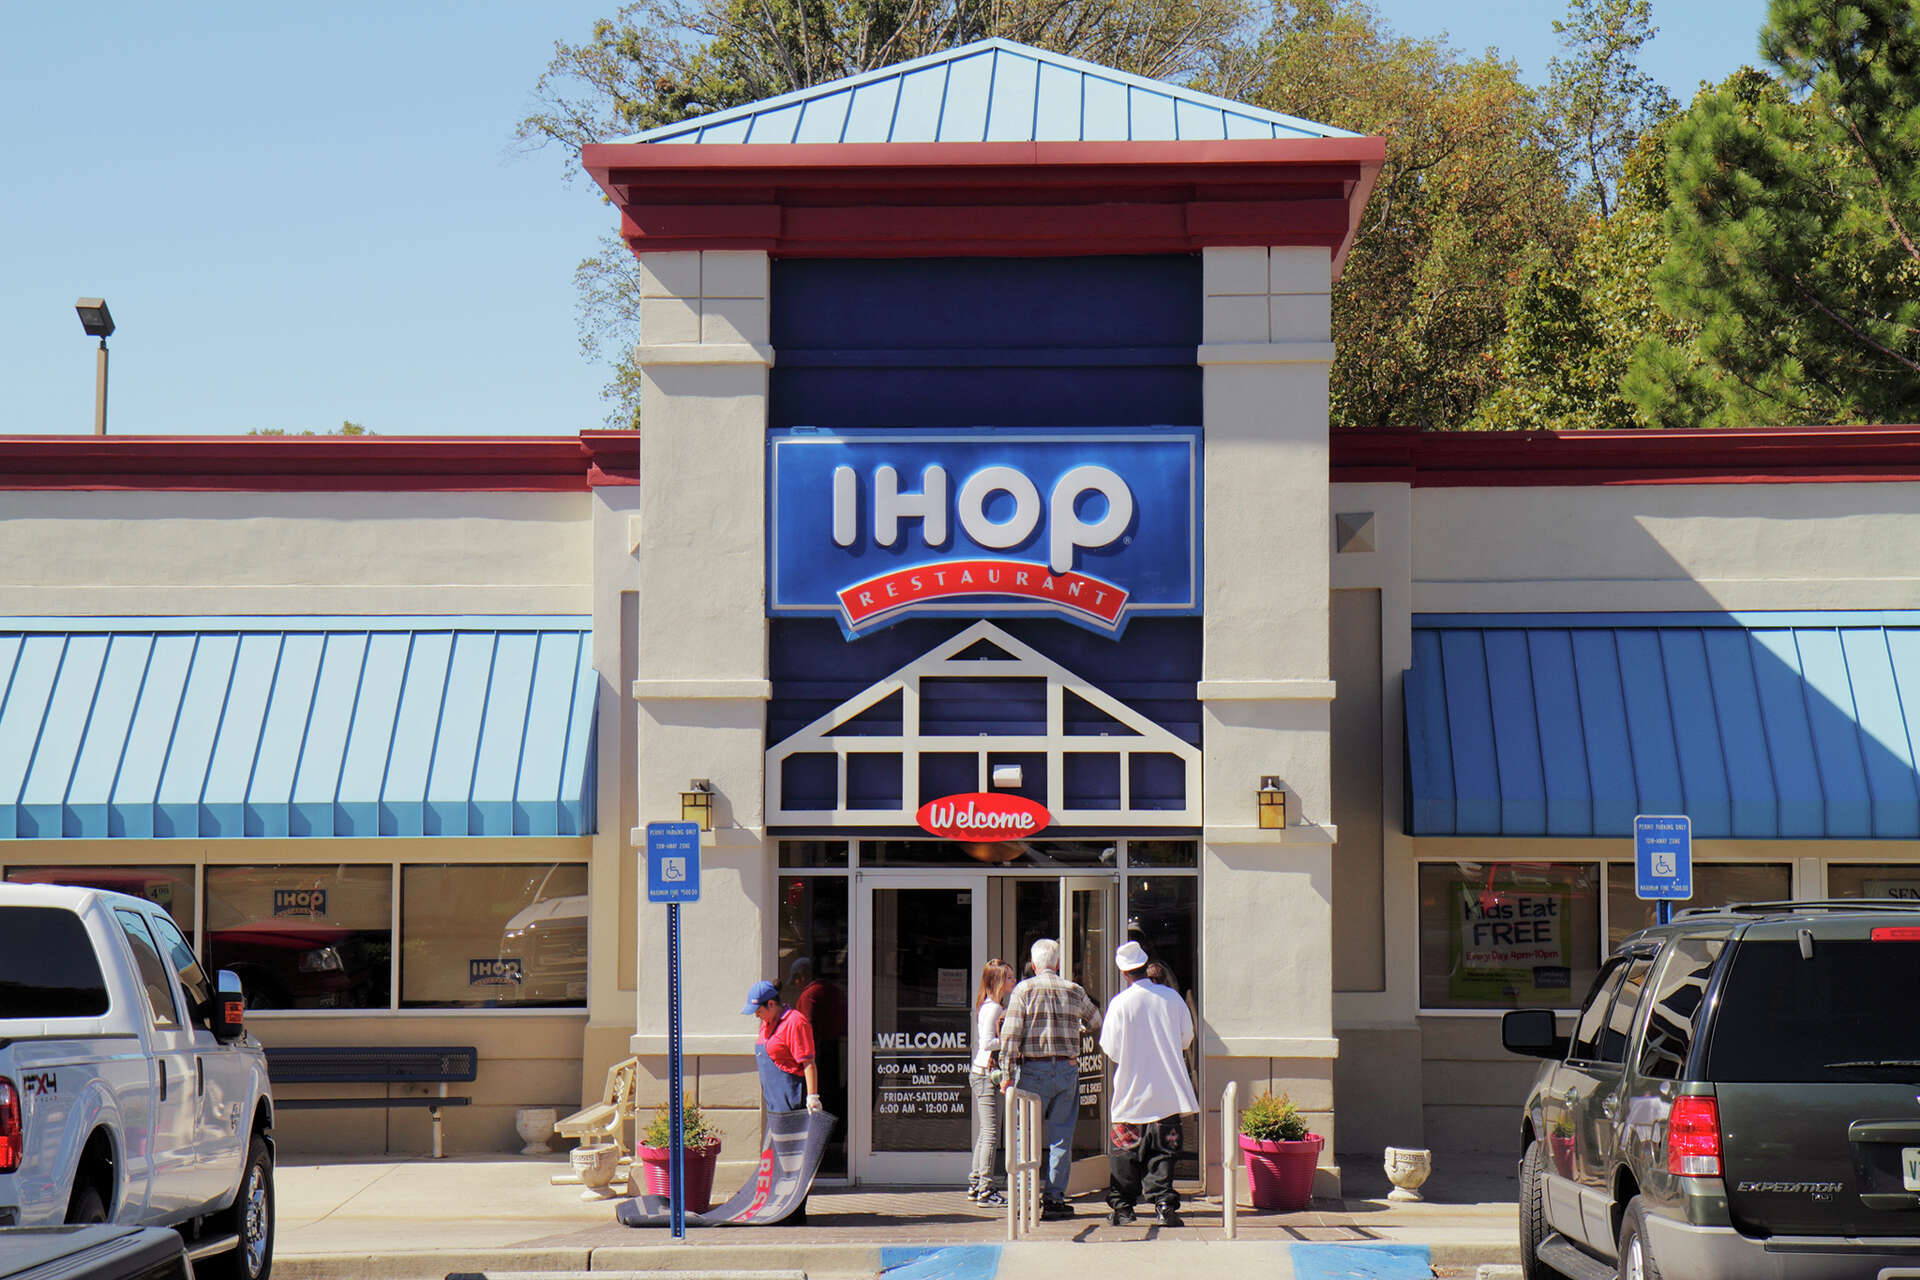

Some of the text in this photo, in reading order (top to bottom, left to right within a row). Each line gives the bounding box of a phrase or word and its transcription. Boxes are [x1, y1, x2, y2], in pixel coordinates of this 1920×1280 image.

[833, 465, 1134, 574] IHOP
[858, 569, 1108, 608] RESTAURANT
[930, 800, 1036, 830] Welcome
[276, 893, 324, 911] IHOP
[1464, 897, 1558, 921] Kids Eat
[1473, 920, 1553, 946] FREE
[1465, 951, 1491, 962] Every
[1491, 950, 1508, 961] Day
[877, 1031, 967, 1049] WELCOME
[1082, 1035, 1095, 1054] NO
[877, 1063, 900, 1074] 6:00
[902, 1063, 917, 1074] AM
[927, 1063, 955, 1074] 10:00
[957, 1063, 971, 1073] PM
[912, 1074, 937, 1085] DAILY
[883, 1092, 960, 1102] FRIDAY-SATURDAY
[879, 1103, 899, 1114] 6:00
[901, 1103, 916, 1113] AM
[925, 1103, 948, 1113] 12:00
[951, 1103, 965, 1113] AM
[1736, 1180, 1845, 1193] EXPEDITION
